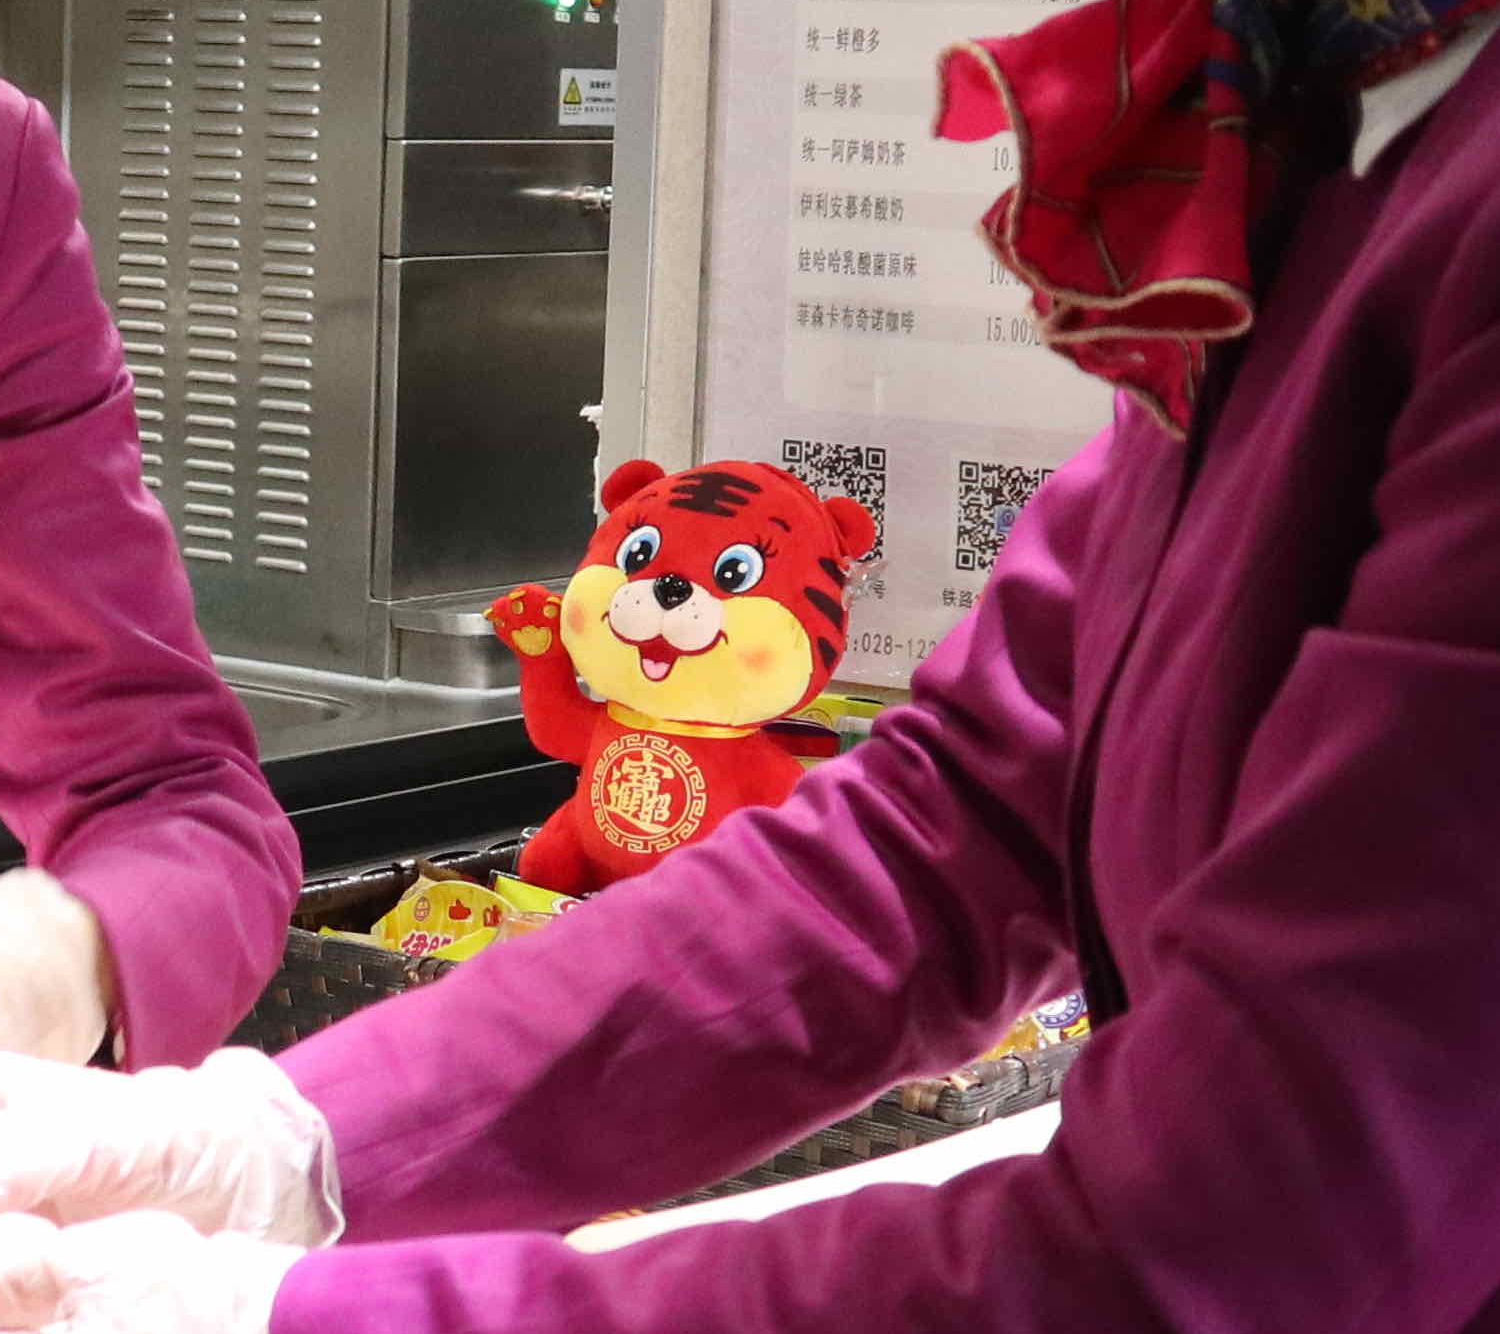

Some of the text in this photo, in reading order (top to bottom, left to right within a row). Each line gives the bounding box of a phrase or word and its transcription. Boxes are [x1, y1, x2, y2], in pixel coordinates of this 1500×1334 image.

[807, 26, 881, 53] 统一鲜橙多
[804, 82, 863, 108] 统一绿茶
[802, 137, 1014, 172] 统一阿萨姆奶茶 10.
[800, 192, 904, 222] 伊利安慕希酸奶
[798, 247, 917, 278] 娃哈哈乳酸菌原味
[942, 587, 980, 608] 铁路
